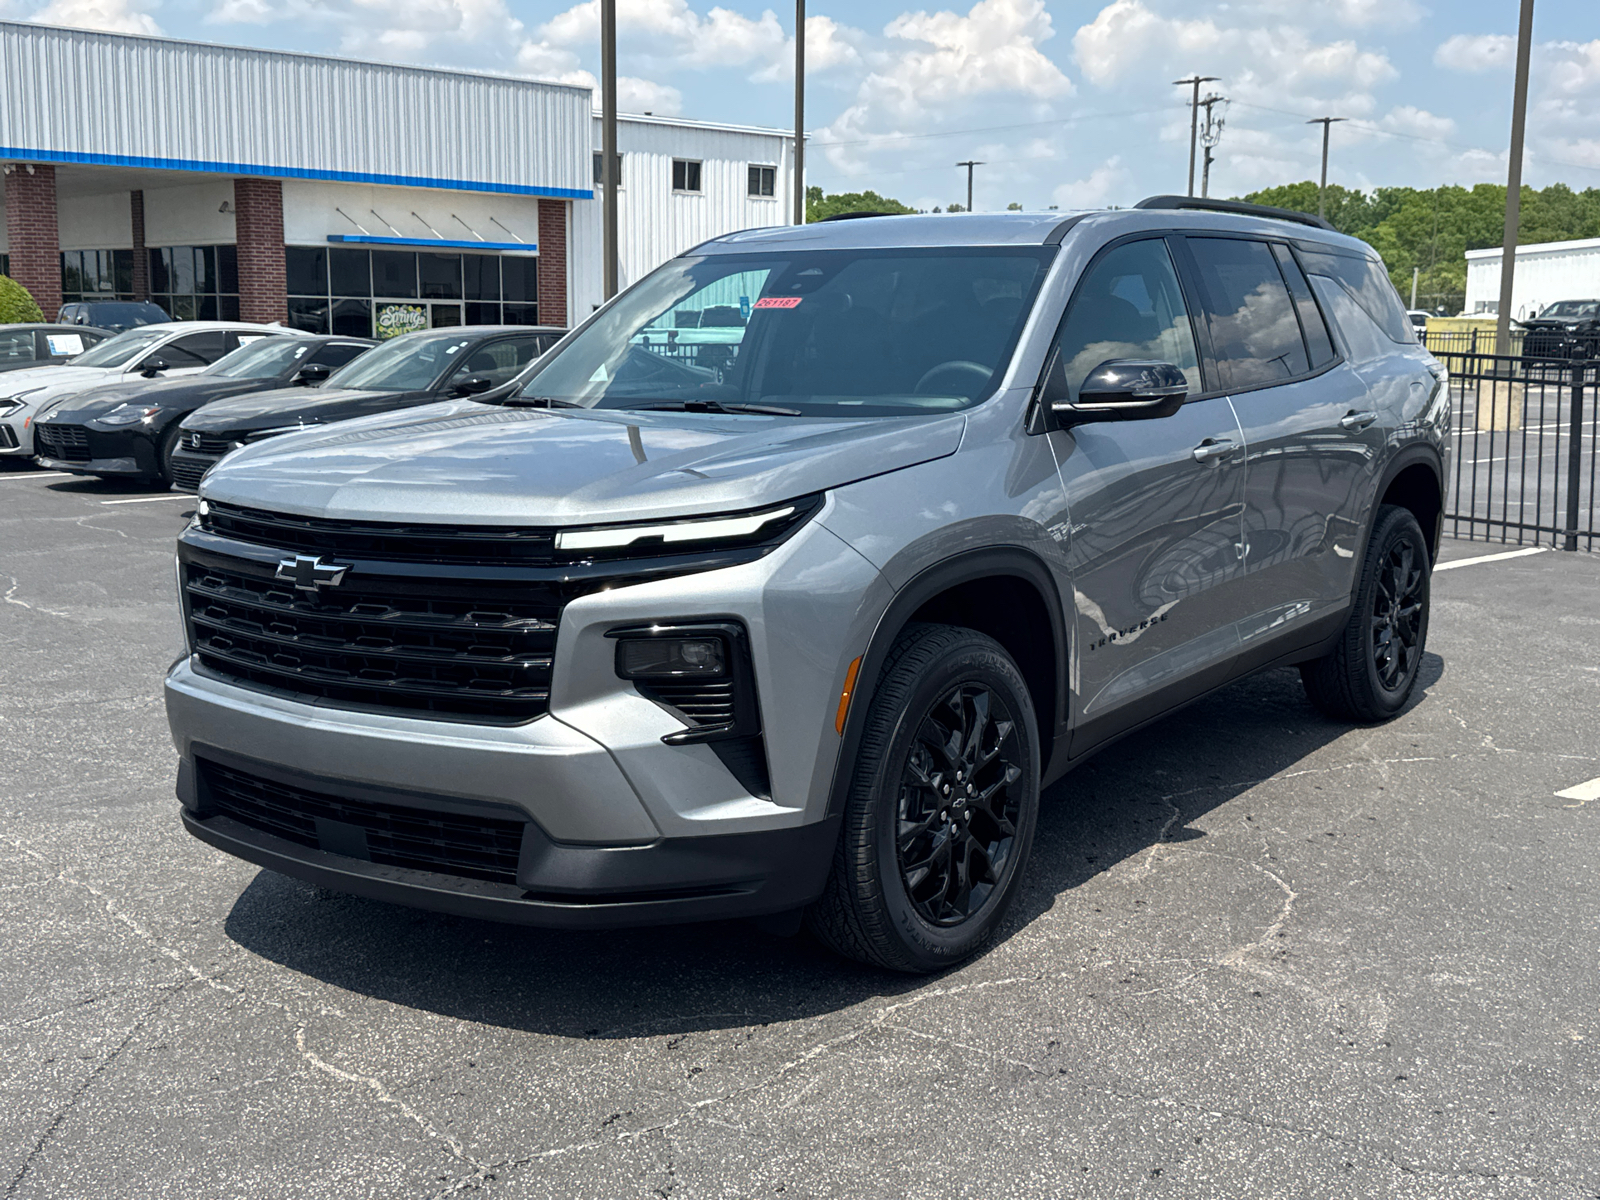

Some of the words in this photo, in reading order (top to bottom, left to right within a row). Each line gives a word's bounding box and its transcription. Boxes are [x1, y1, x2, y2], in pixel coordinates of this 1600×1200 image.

[757, 299, 799, 307] 261187
[380, 305, 421, 328] Spring
[1089, 613, 1169, 651] TRAVERSE
